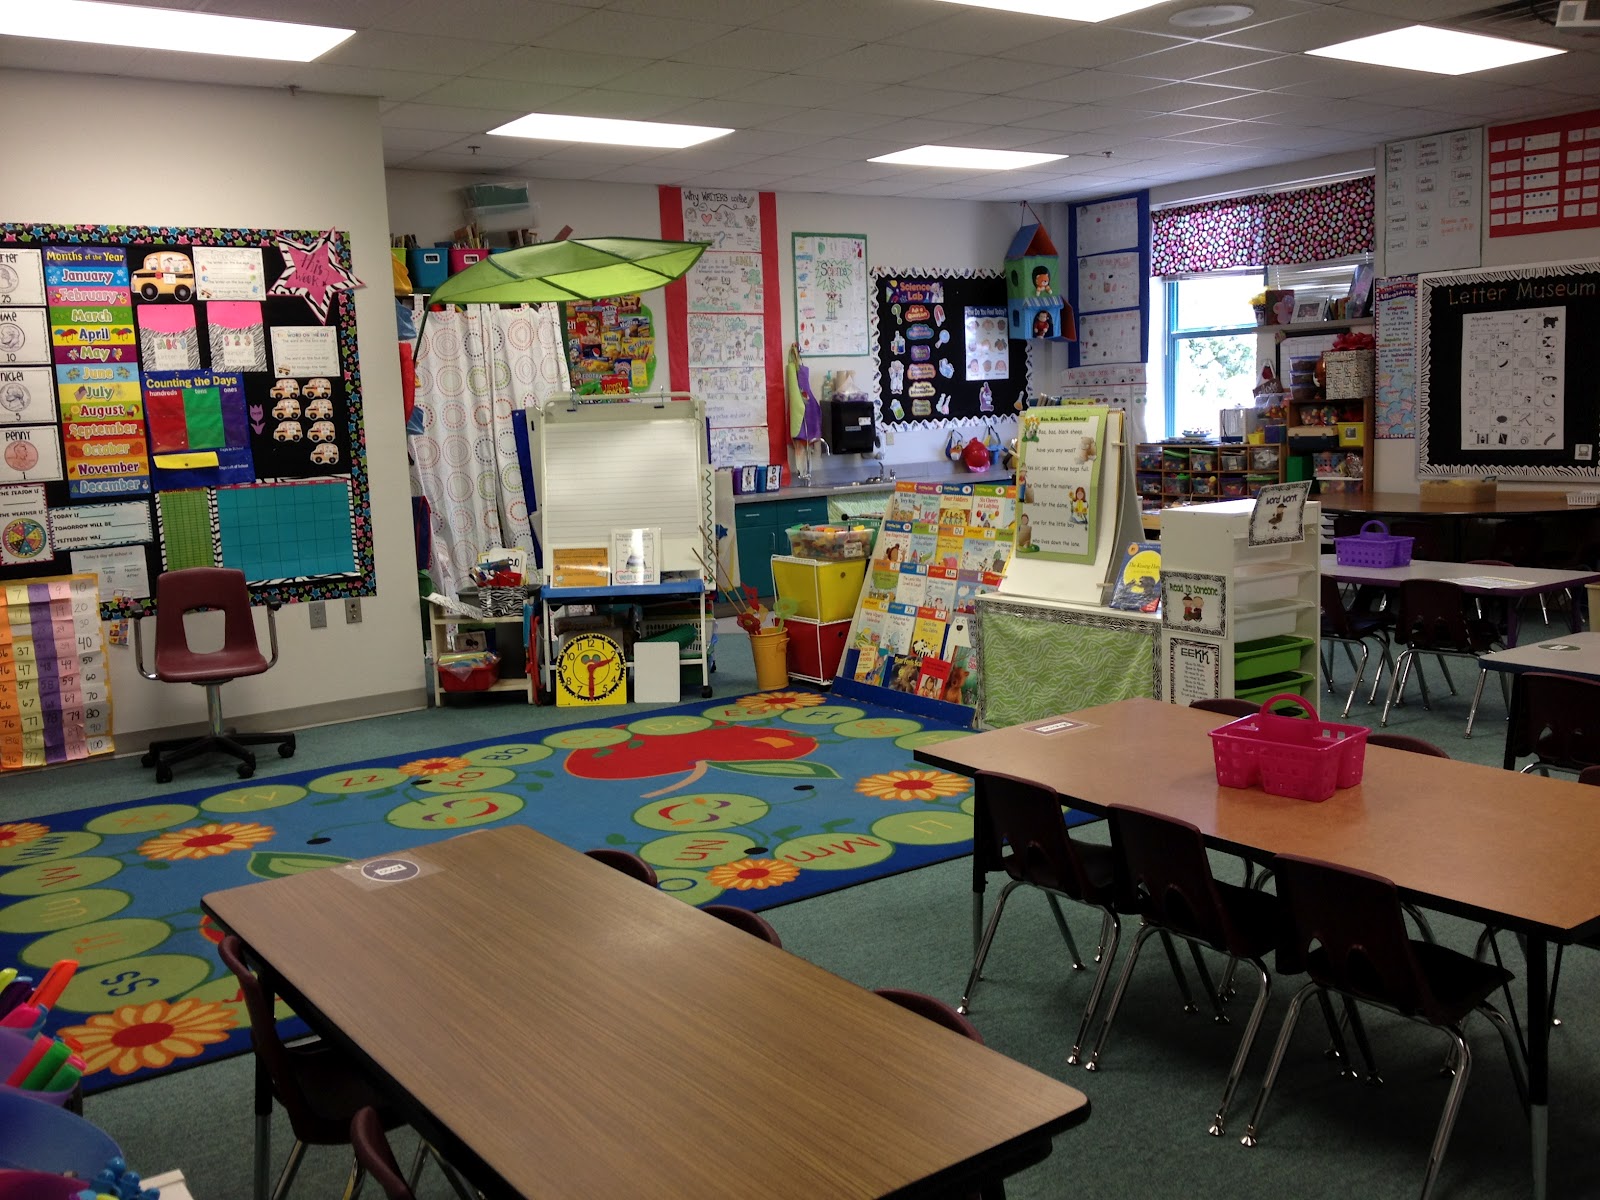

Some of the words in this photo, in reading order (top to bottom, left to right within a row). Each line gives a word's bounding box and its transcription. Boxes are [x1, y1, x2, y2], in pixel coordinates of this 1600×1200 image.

[684, 191, 699, 207] Why
[46, 251, 83, 262] Months
[103, 251, 125, 262] Year
[300, 253, 324, 275] This
[62, 269, 115, 285] January
[900, 282, 931, 292] Science
[60, 287, 118, 305] February
[908, 292, 923, 300] Lab
[1449, 287, 1508, 305] Letter
[1516, 282, 1596, 300] Museum
[2, 294, 11, 304] 25
[71, 309, 112, 323] March
[79, 328, 110, 342] April
[7, 353, 16, 362] 10
[80, 347, 110, 362] May
[82, 367, 114, 380] June
[146, 377, 192, 389] Counting
[194, 376, 210, 386] the
[212, 375, 237, 387] Days
[86, 385, 114, 400] July
[16, 413, 21, 421] 5
[80, 405, 125, 419] August
[69, 423, 138, 439] September
[82, 442, 131, 456] October
[77, 461, 140, 476] November
[22, 472, 27, 480] 1
[79, 479, 140, 494] December
[1266, 495, 1281, 505] word
[56, 536, 88, 544] YESTERDAY
[13, 589, 21, 600] 7
[75, 583, 86, 594] 10
[1169, 583, 1183, 592] Read
[1194, 585, 1219, 596] Someone
[74, 603, 88, 613] 20
[78, 637, 92, 649] 40
[577, 643, 583, 651] 11
[587, 639, 594, 648] 12
[601, 642, 605, 650] 1
[17, 647, 29, 656] 37
[566, 652, 575, 661] 10
[611, 651, 616, 659] 2
[1180, 646, 1210, 664] EEKK
[61, 660, 72, 670] 49
[82, 656, 93, 664] 50
[19, 665, 30, 675] 47
[562, 665, 568, 673] 9
[615, 663, 620, 671] 3
[62, 677, 73, 686] 59
[86, 673, 96, 681] 60
[566, 677, 571, 685] 8
[19, 681, 29, 690] 57
[602, 684, 607, 693] 5
[65, 694, 75, 703] 69
[87, 692, 98, 701] 70
[22, 699, 34, 707] 67
[66, 711, 80, 720] 79
[86, 709, 99, 719] 80
[2, 720, 14, 728] 76
[24, 717, 38, 726] 77
[90, 740, 103, 750] 100
